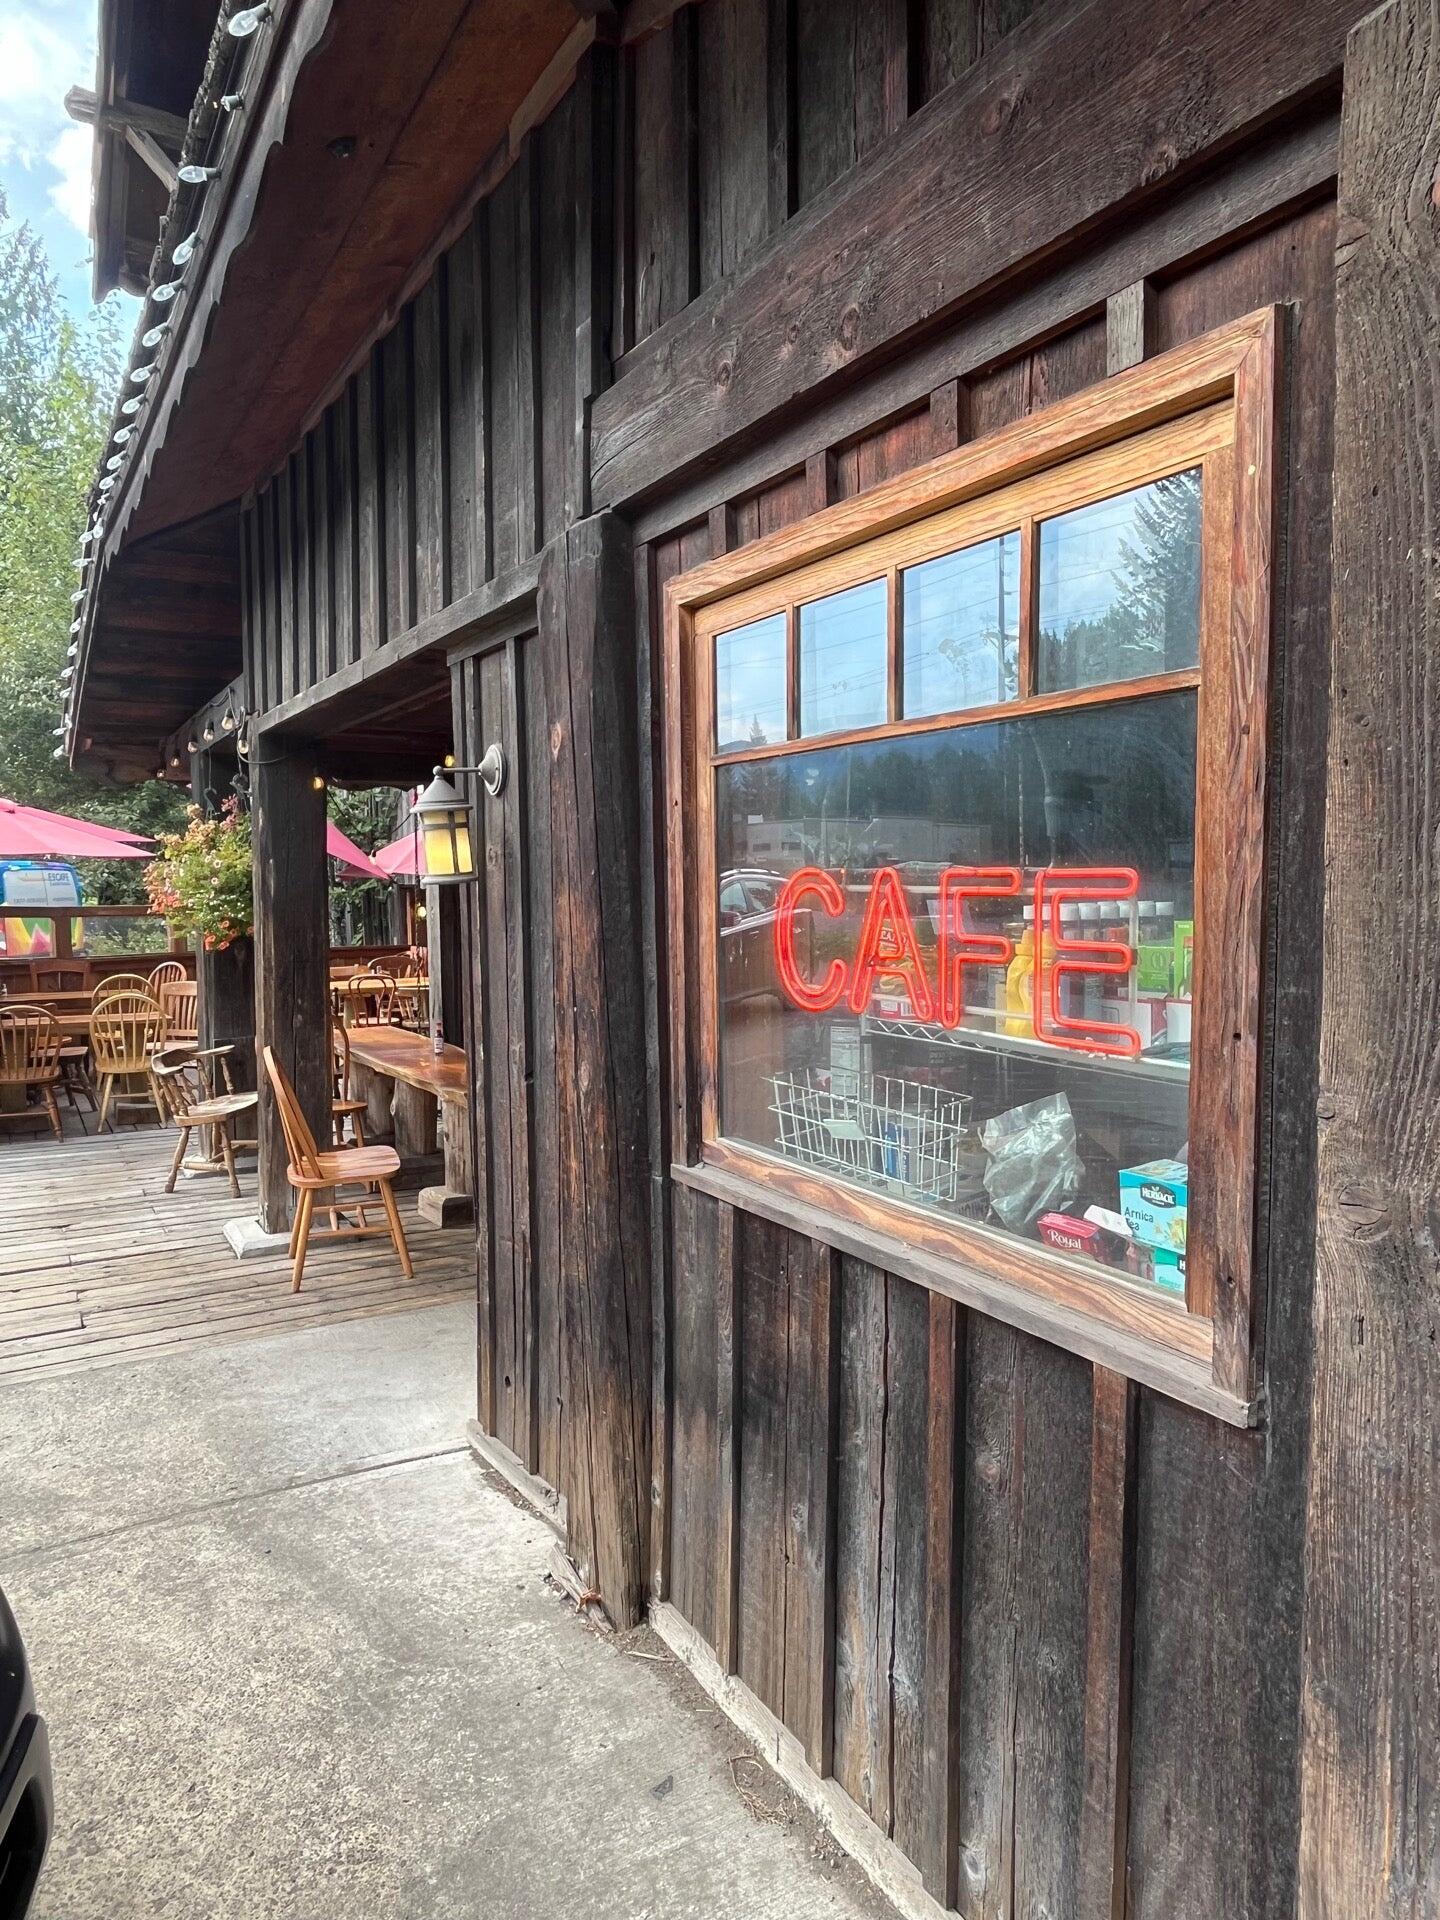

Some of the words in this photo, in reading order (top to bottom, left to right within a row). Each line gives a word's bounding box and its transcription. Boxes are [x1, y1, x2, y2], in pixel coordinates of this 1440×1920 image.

[775, 867, 1141, 1056] CAFE
[1125, 1206, 1154, 1223] Arnica
[1047, 1229, 1082, 1249] Royal
